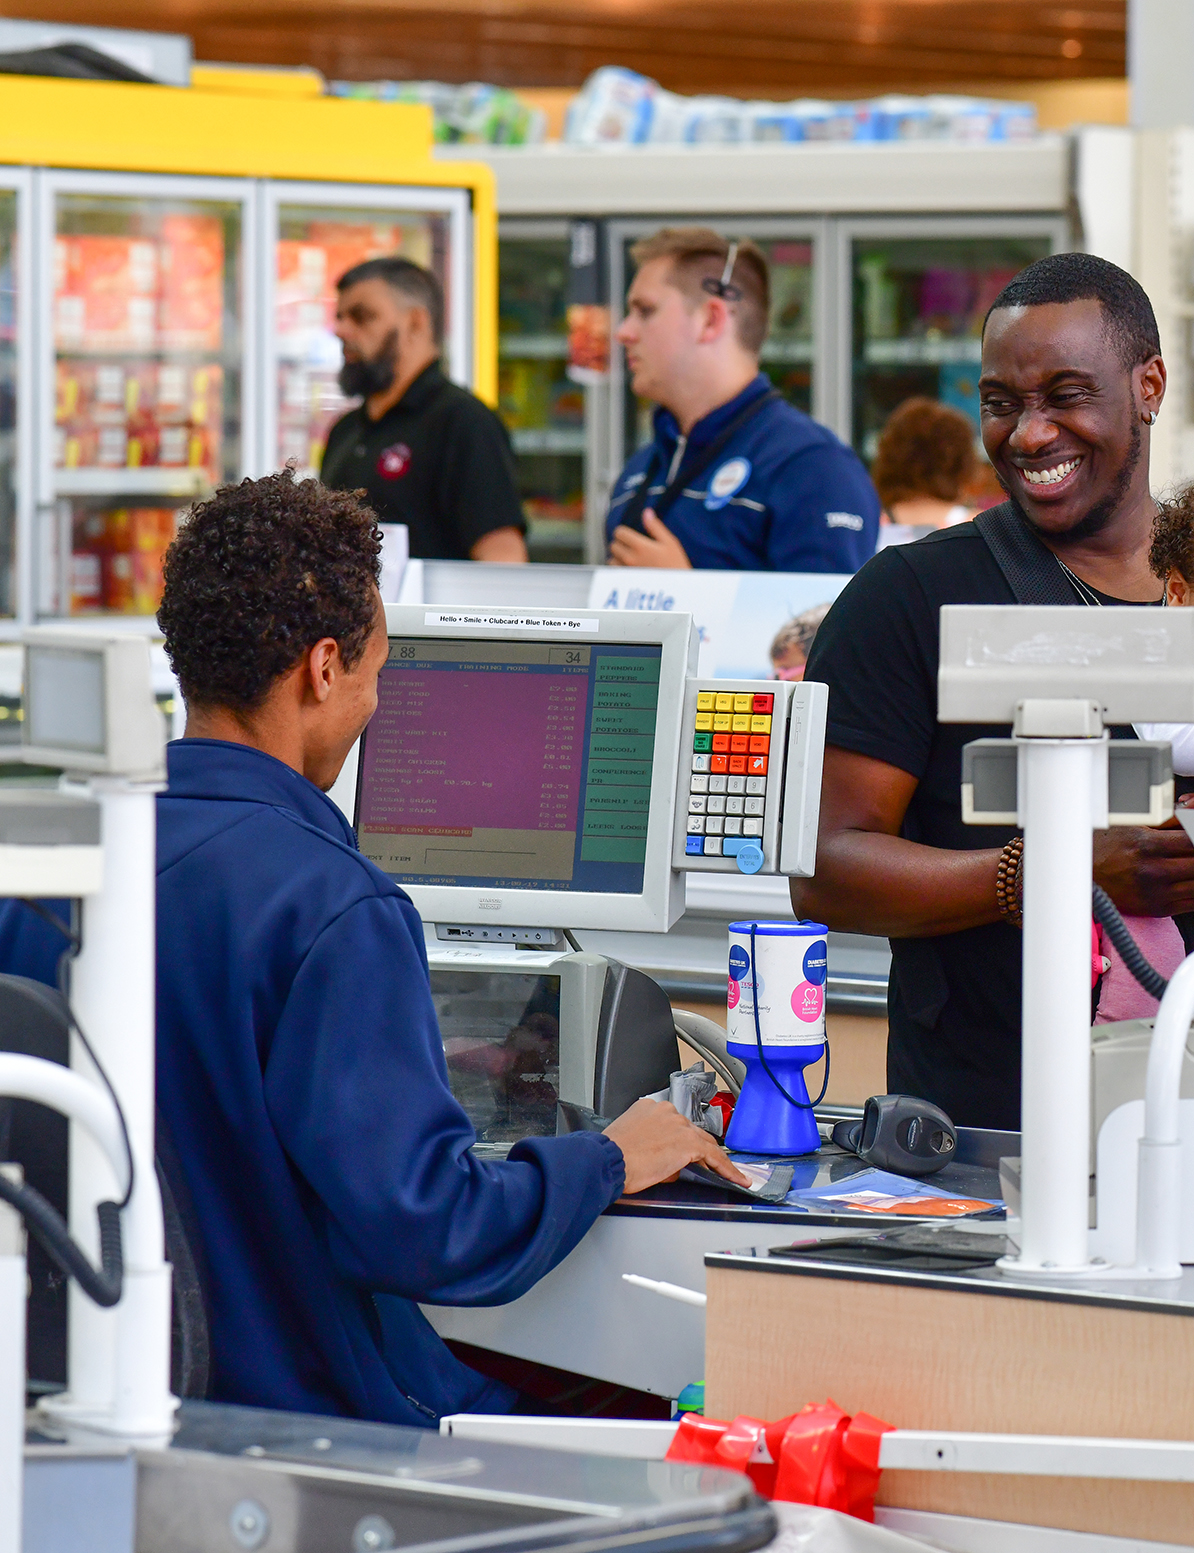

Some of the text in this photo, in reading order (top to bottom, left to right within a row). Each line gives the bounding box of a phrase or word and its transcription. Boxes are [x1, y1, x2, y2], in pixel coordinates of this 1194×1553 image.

[603, 588, 675, 611] A little
[440, 615, 457, 623] Hello
[463, 616, 482, 624] Smile
[489, 617, 519, 625] Clubcard
[542, 619, 562, 627] Token
[568, 620, 581, 628] Bye
[565, 651, 581, 664] 34
[592, 768, 647, 776] CONFERENCE
